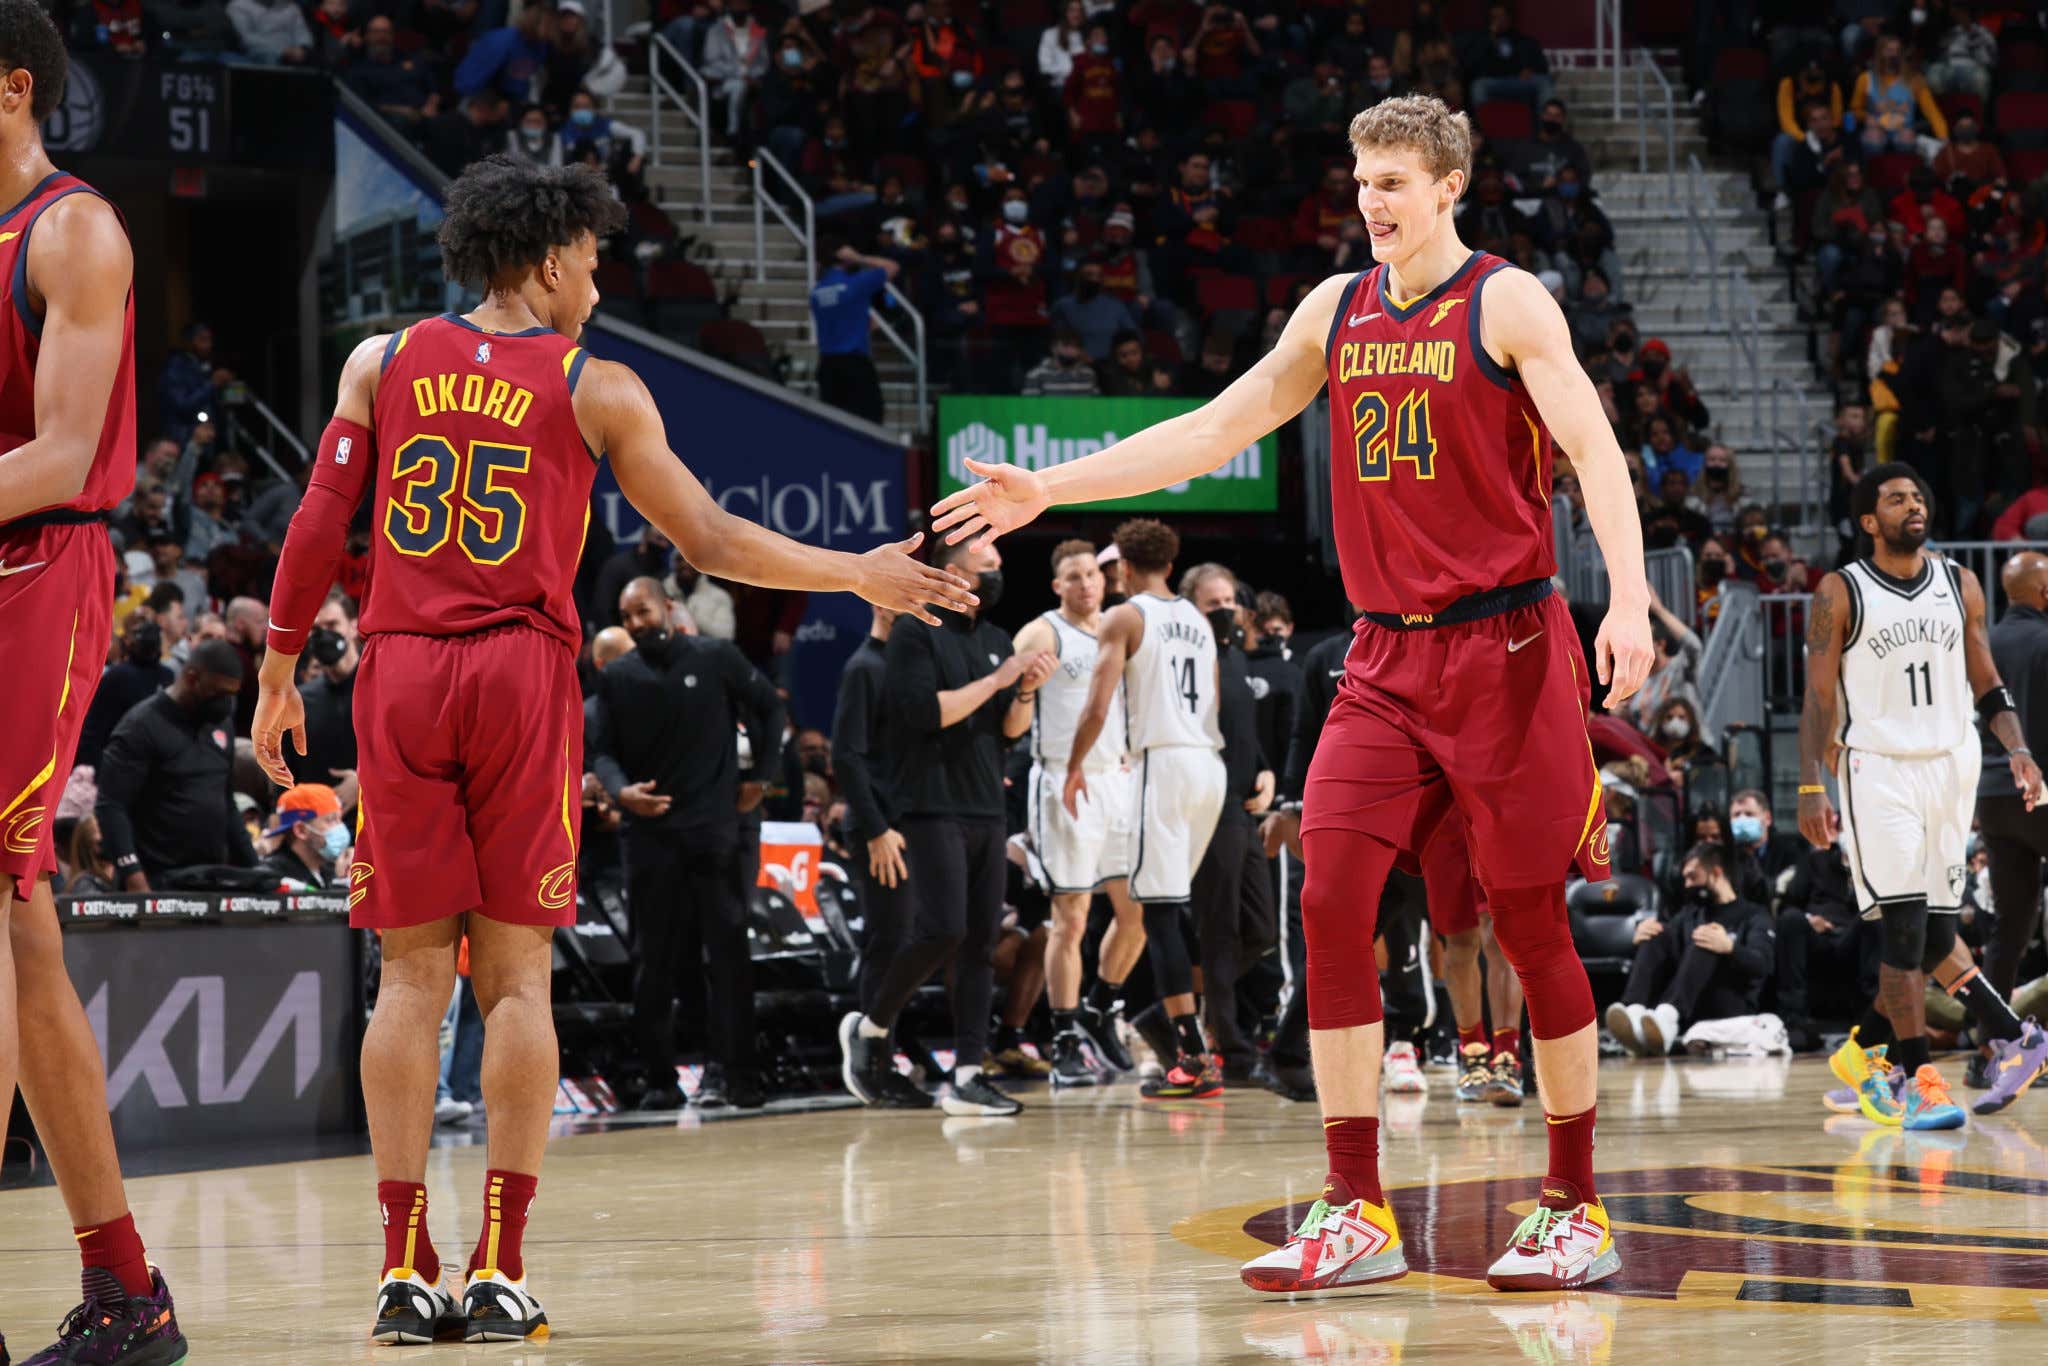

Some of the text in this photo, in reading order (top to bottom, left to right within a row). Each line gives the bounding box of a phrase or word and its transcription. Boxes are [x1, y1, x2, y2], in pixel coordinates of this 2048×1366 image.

[170, 107, 209, 151] 51
[1339, 341, 1456, 383] CLEVELAND
[412, 373, 534, 427] OKORO
[1352, 388, 1438, 482] 24
[384, 433, 532, 566] 35
[1867, 617, 1960, 660] BROOKLYN
[1171, 655, 1199, 714] 14
[1904, 660, 1932, 707] 11
